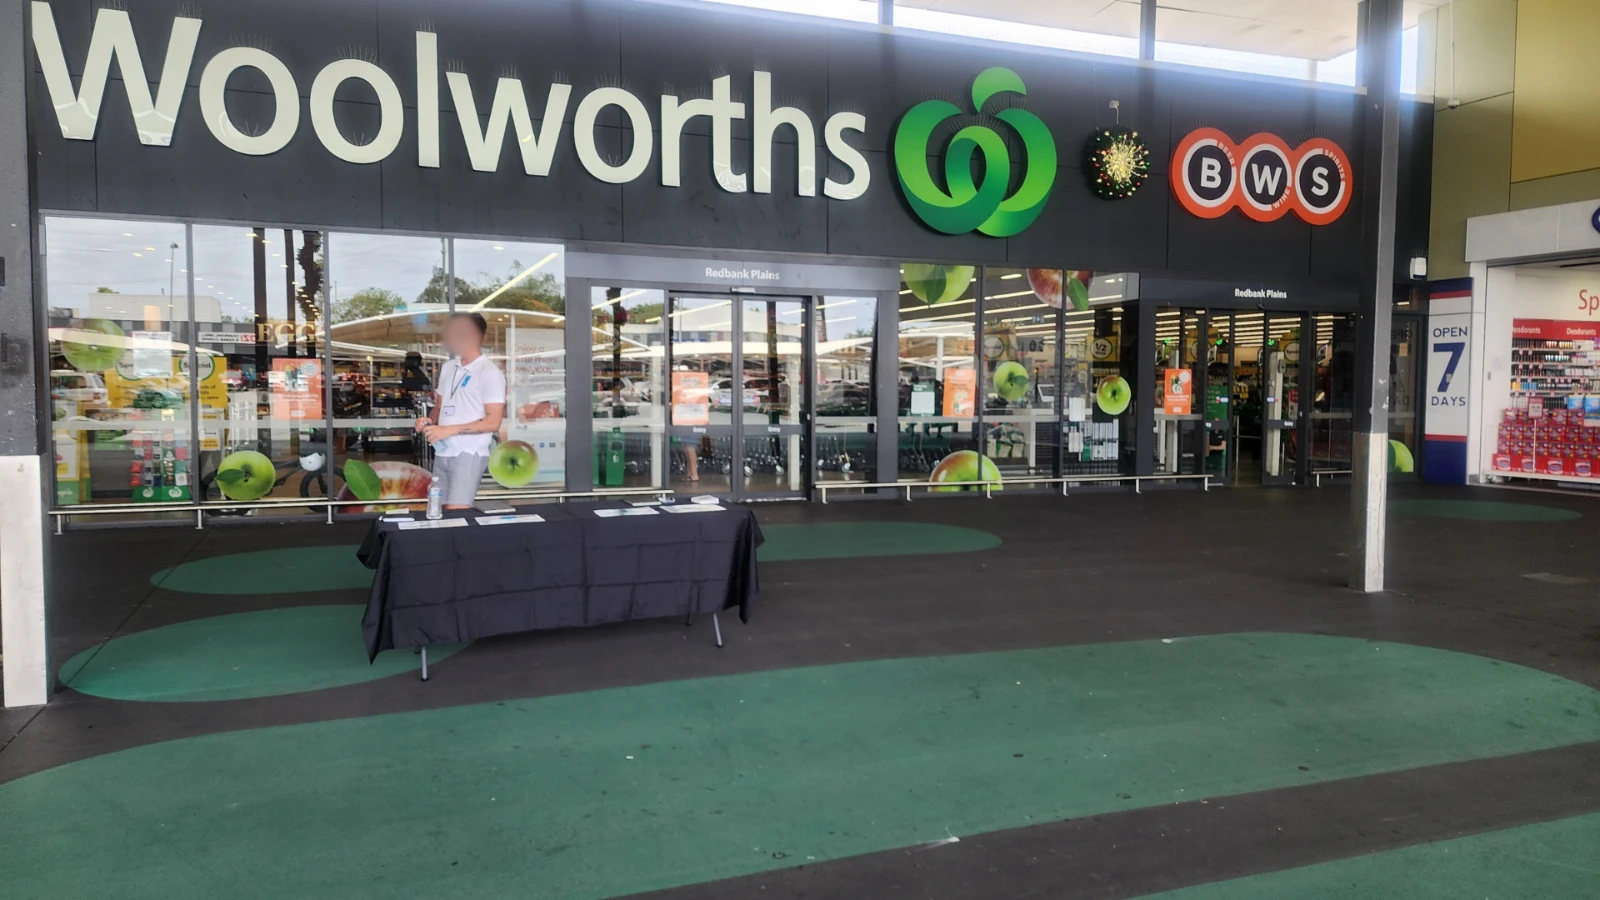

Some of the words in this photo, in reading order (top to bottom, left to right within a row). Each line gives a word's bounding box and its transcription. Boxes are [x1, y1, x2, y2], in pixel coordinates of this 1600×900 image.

[31, 1, 870, 200] Woolworths
[1217, 142, 1236, 166] BEER
[1323, 149, 1346, 180] SPIRITS
[1272, 189, 1291, 209] WINE
[705, 267, 750, 280] Redbank
[750, 269, 780, 281] Plains
[1234, 288, 1265, 298] Redbank
[1266, 289, 1288, 299] Plains
[1433, 326, 1469, 338] OPEN
[1512, 326, 1541, 335] eodorants
[1566, 327, 1597, 337] Deodorants
[1095, 342, 1107, 351] 1/2
[1433, 342, 1466, 393] 7
[1431, 396, 1466, 407] DAYS
[692, 426, 707, 434] Entry
[767, 426, 781, 434] Entry
